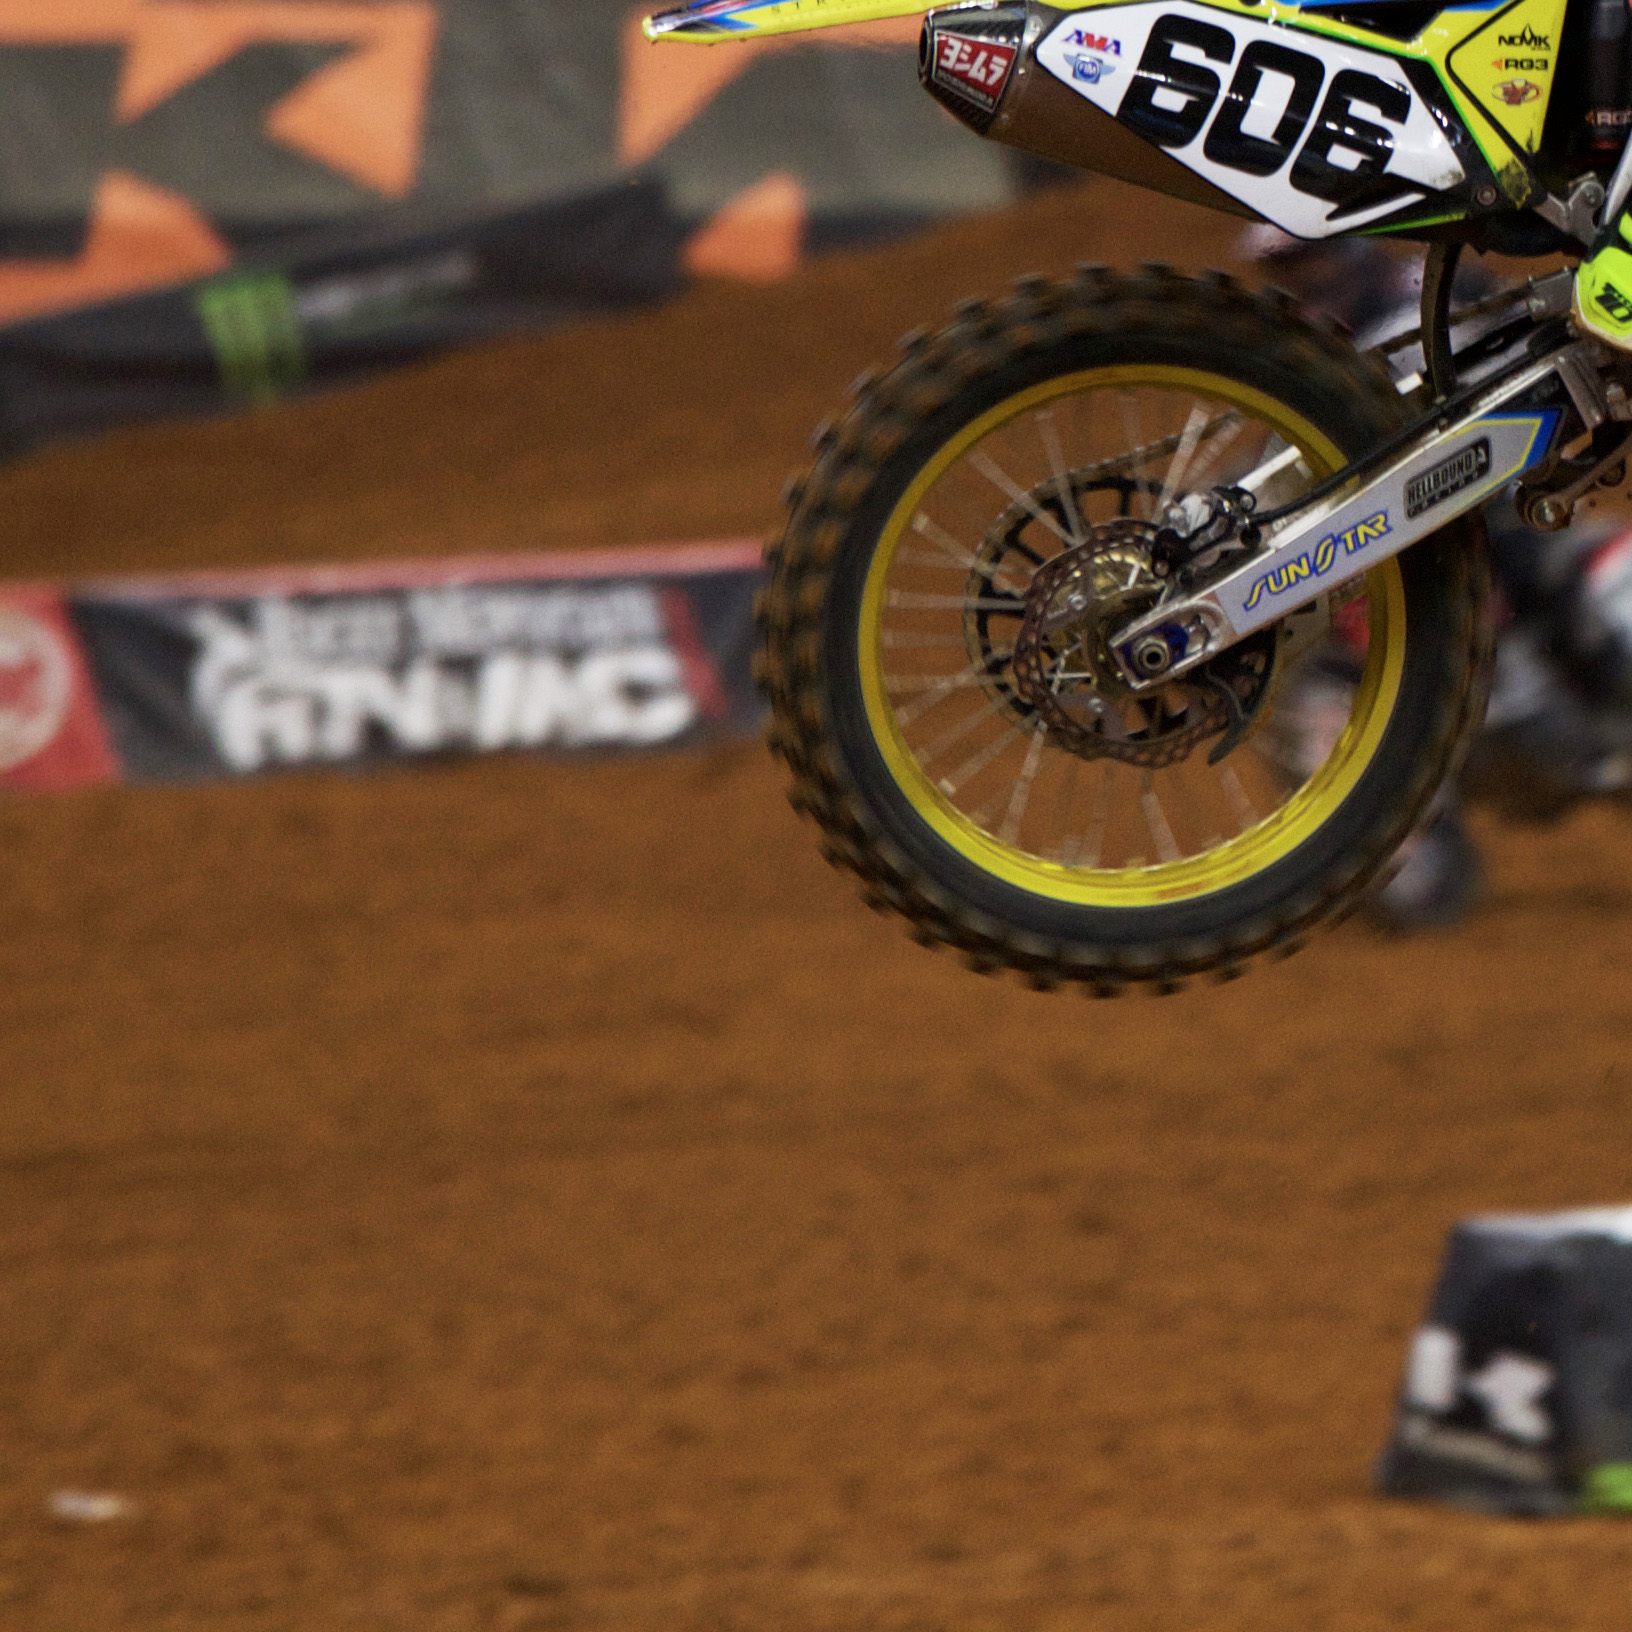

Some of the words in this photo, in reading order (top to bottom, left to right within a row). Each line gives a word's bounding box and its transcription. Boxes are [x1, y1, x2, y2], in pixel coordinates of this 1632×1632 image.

[939, 35, 1008, 87] ヨシムラ
[1061, 27, 1123, 58] AMA
[1116, 13, 1413, 208] 606
